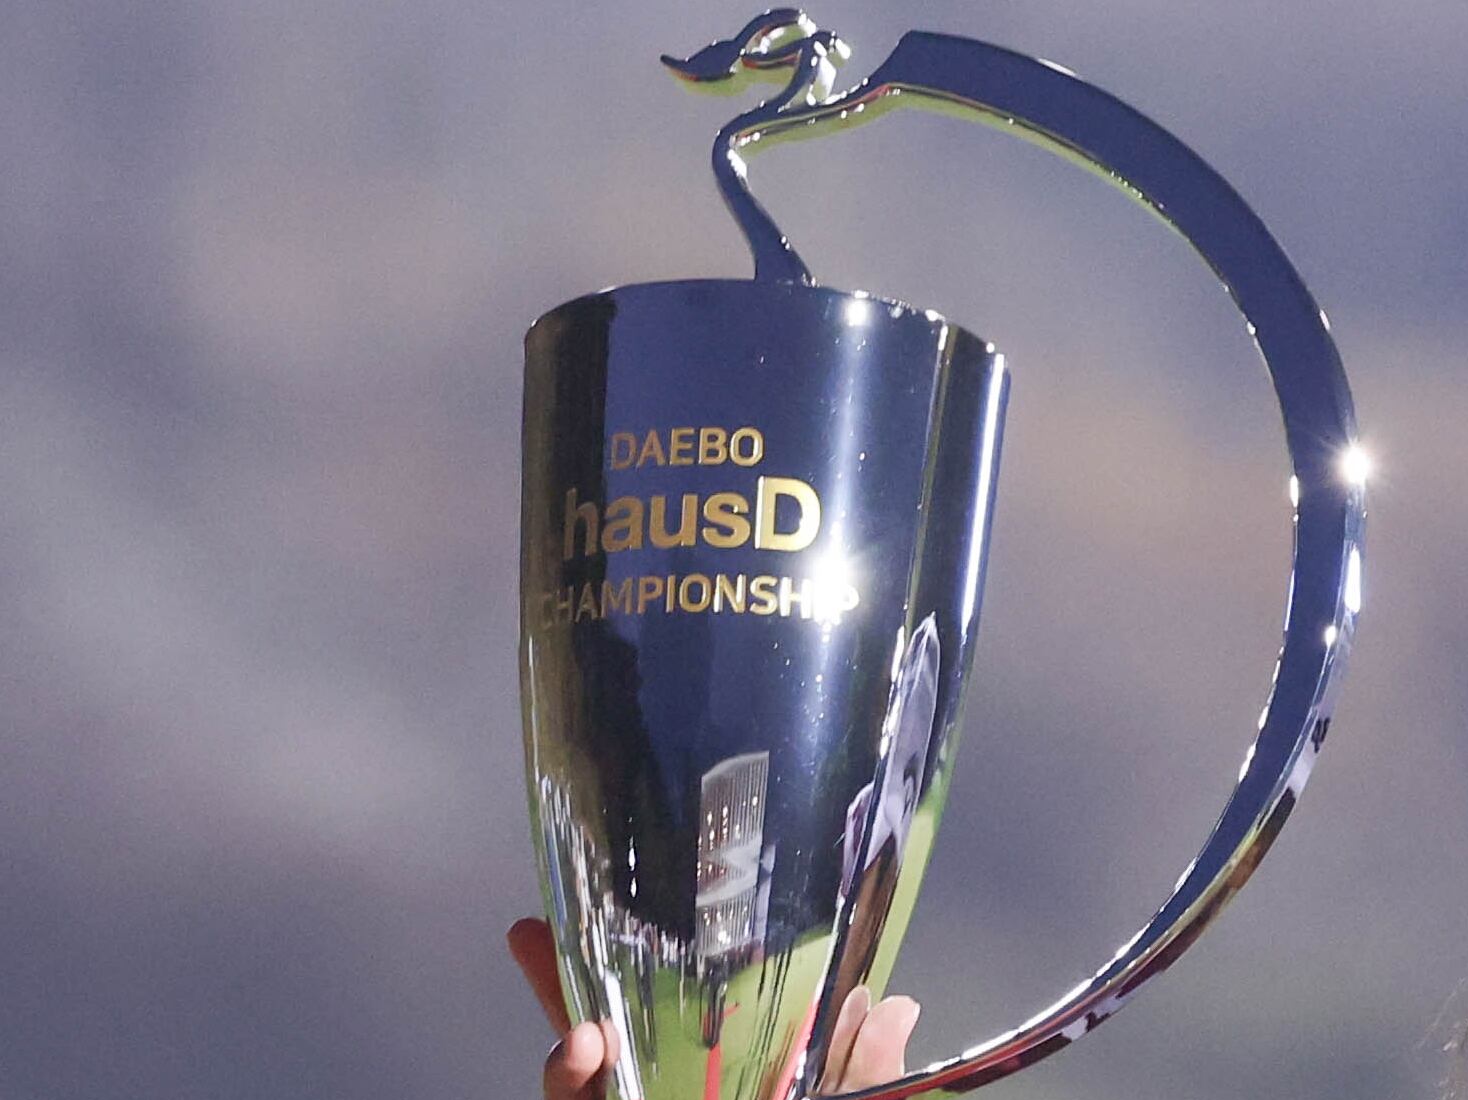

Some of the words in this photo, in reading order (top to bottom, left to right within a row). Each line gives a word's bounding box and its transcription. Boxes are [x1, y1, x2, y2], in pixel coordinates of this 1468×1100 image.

[610, 427, 764, 470] DAEBO
[563, 475, 822, 562] hausD
[540, 573, 860, 628] HAMPIONSHP
